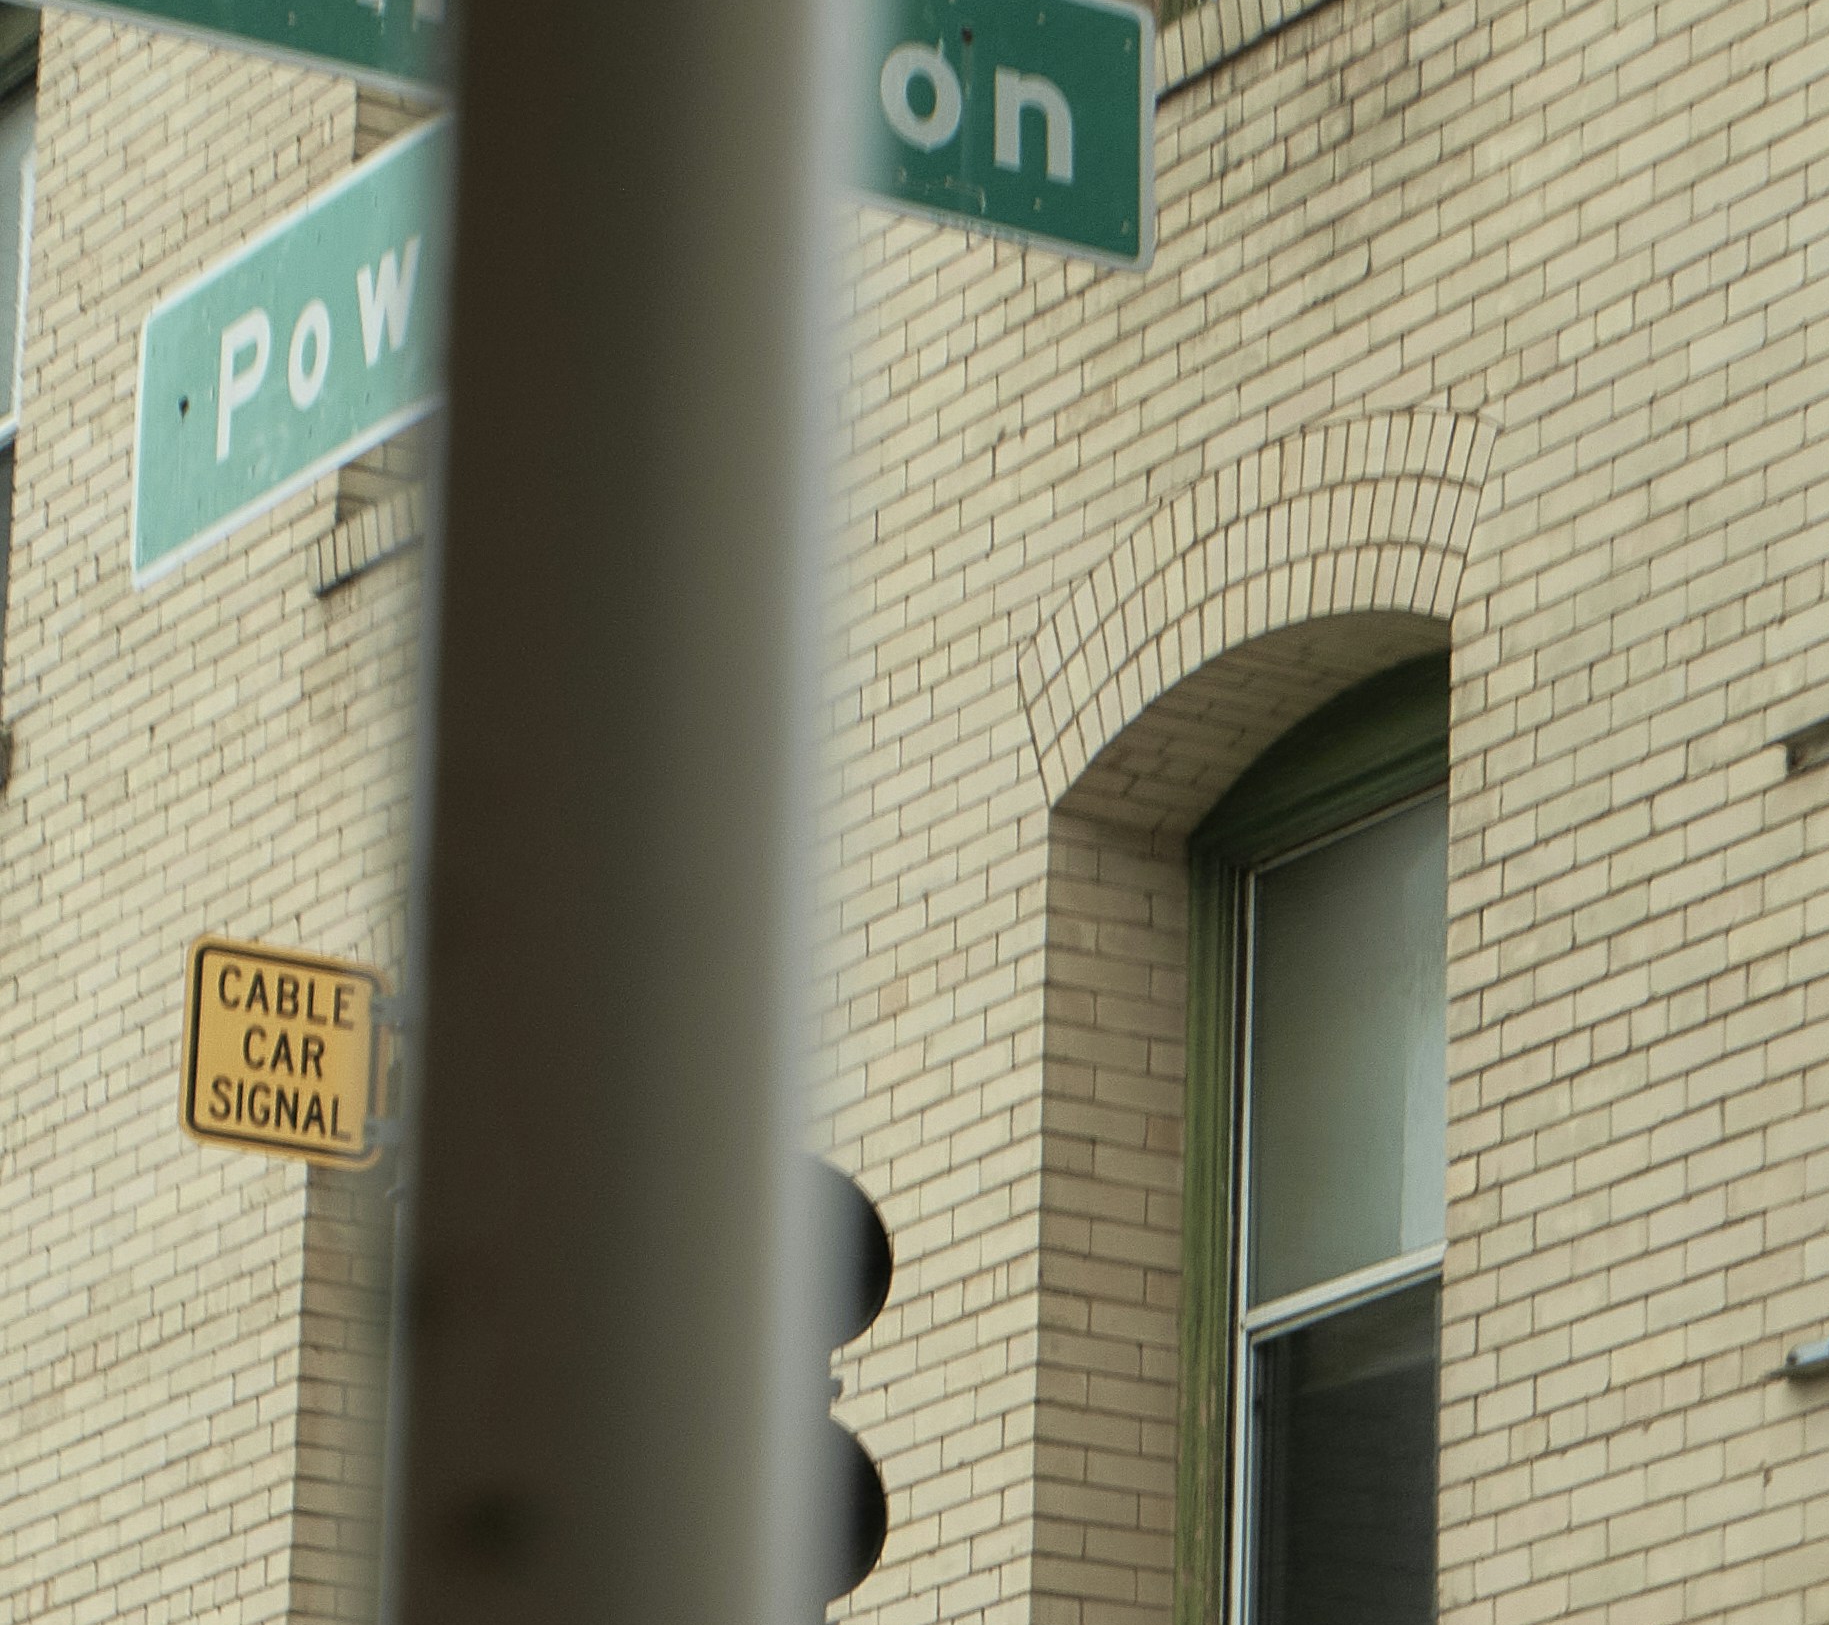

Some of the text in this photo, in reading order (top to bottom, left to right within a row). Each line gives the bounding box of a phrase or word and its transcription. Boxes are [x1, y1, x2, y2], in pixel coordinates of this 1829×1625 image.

[217, 963, 355, 1031] CABLE
[243, 1024, 326, 1080] CAR
[208, 1074, 353, 1141] SIGNAL
